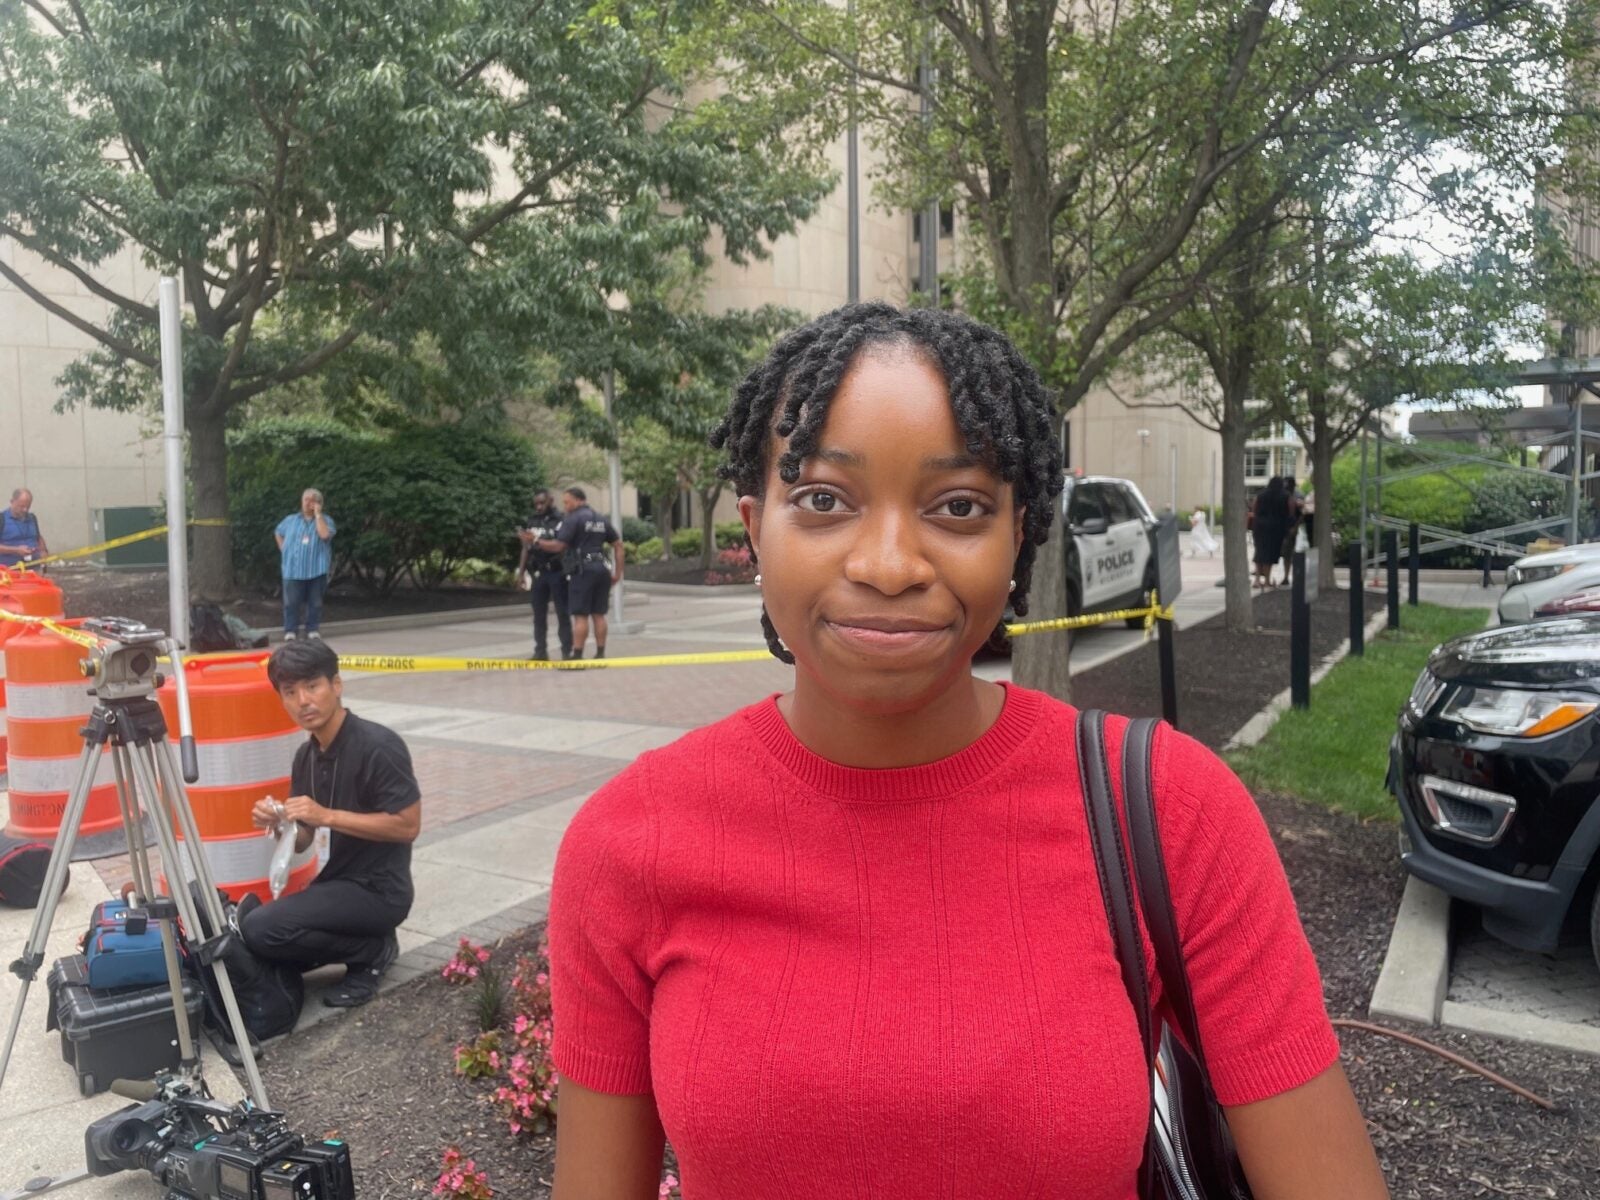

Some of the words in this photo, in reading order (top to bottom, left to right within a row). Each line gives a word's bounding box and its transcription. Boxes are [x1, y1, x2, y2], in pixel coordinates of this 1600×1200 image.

[1098, 550, 1134, 573] POLICE
[355, 656, 376, 668] NOT
[379, 657, 415, 671] CROSS
[467, 661, 505, 671] POLICE
